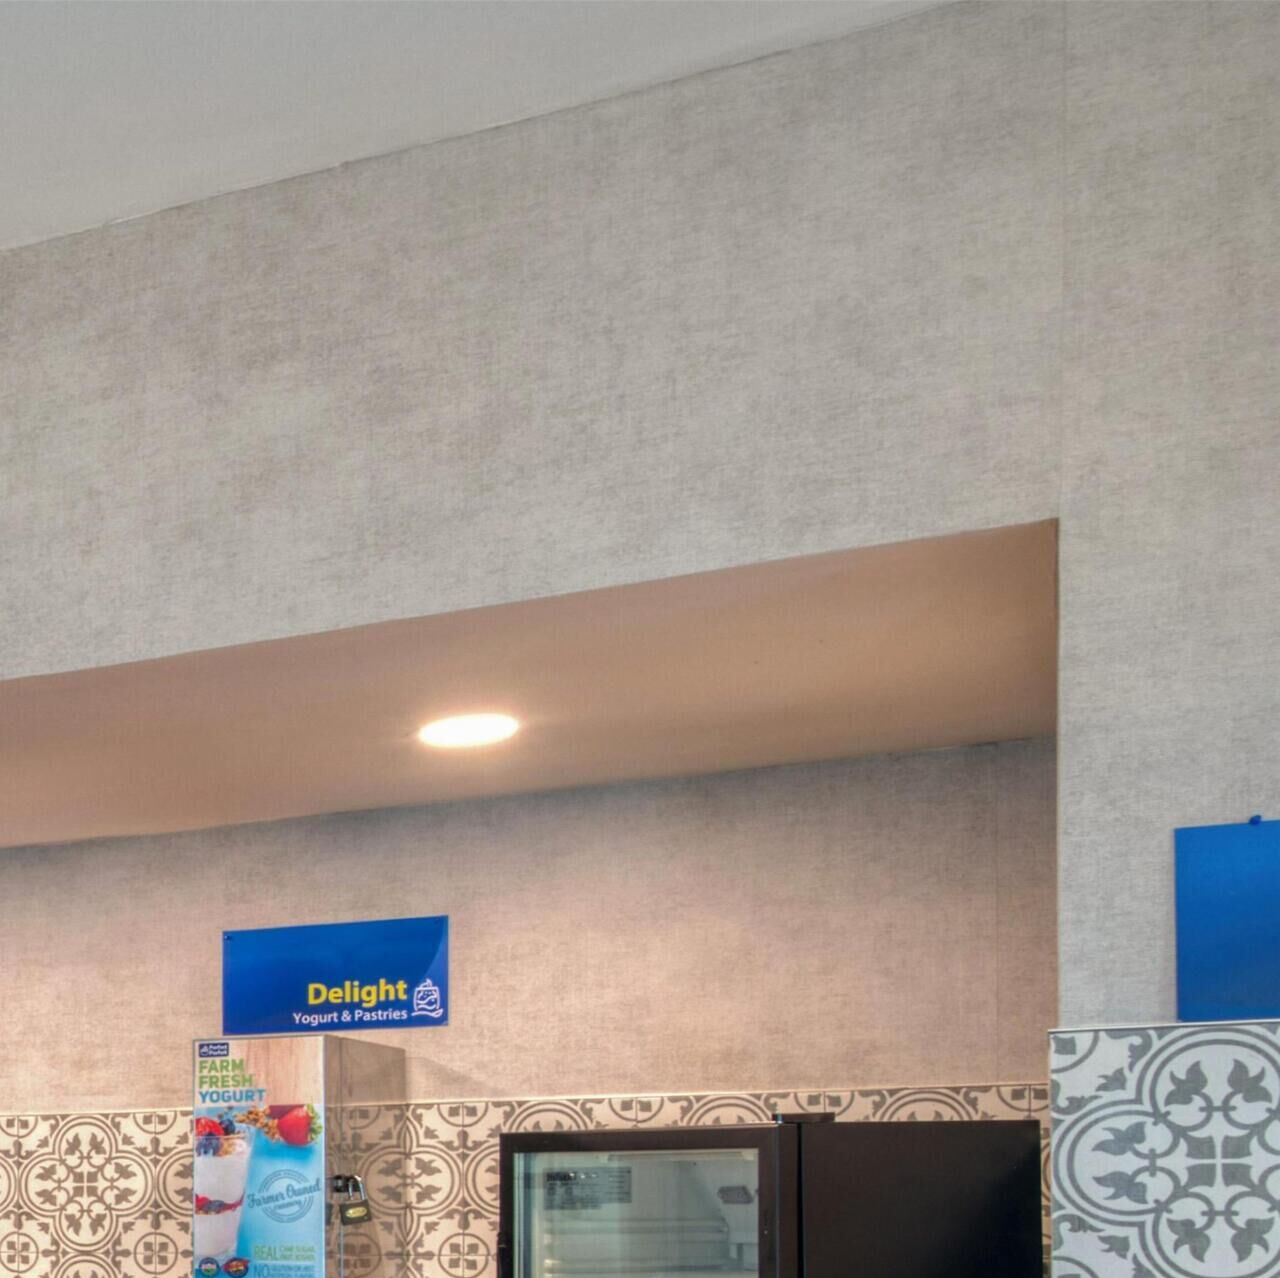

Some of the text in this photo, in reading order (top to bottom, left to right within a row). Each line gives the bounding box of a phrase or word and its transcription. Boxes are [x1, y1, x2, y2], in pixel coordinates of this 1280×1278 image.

[307, 978, 408, 1008] Delight
[293, 1008, 408, 1026] Yogurt & Pastries
[198, 1058, 244, 1073] FARM
[198, 1074, 253, 1088] FRESH
[198, 1088, 267, 1103] YOGURT
